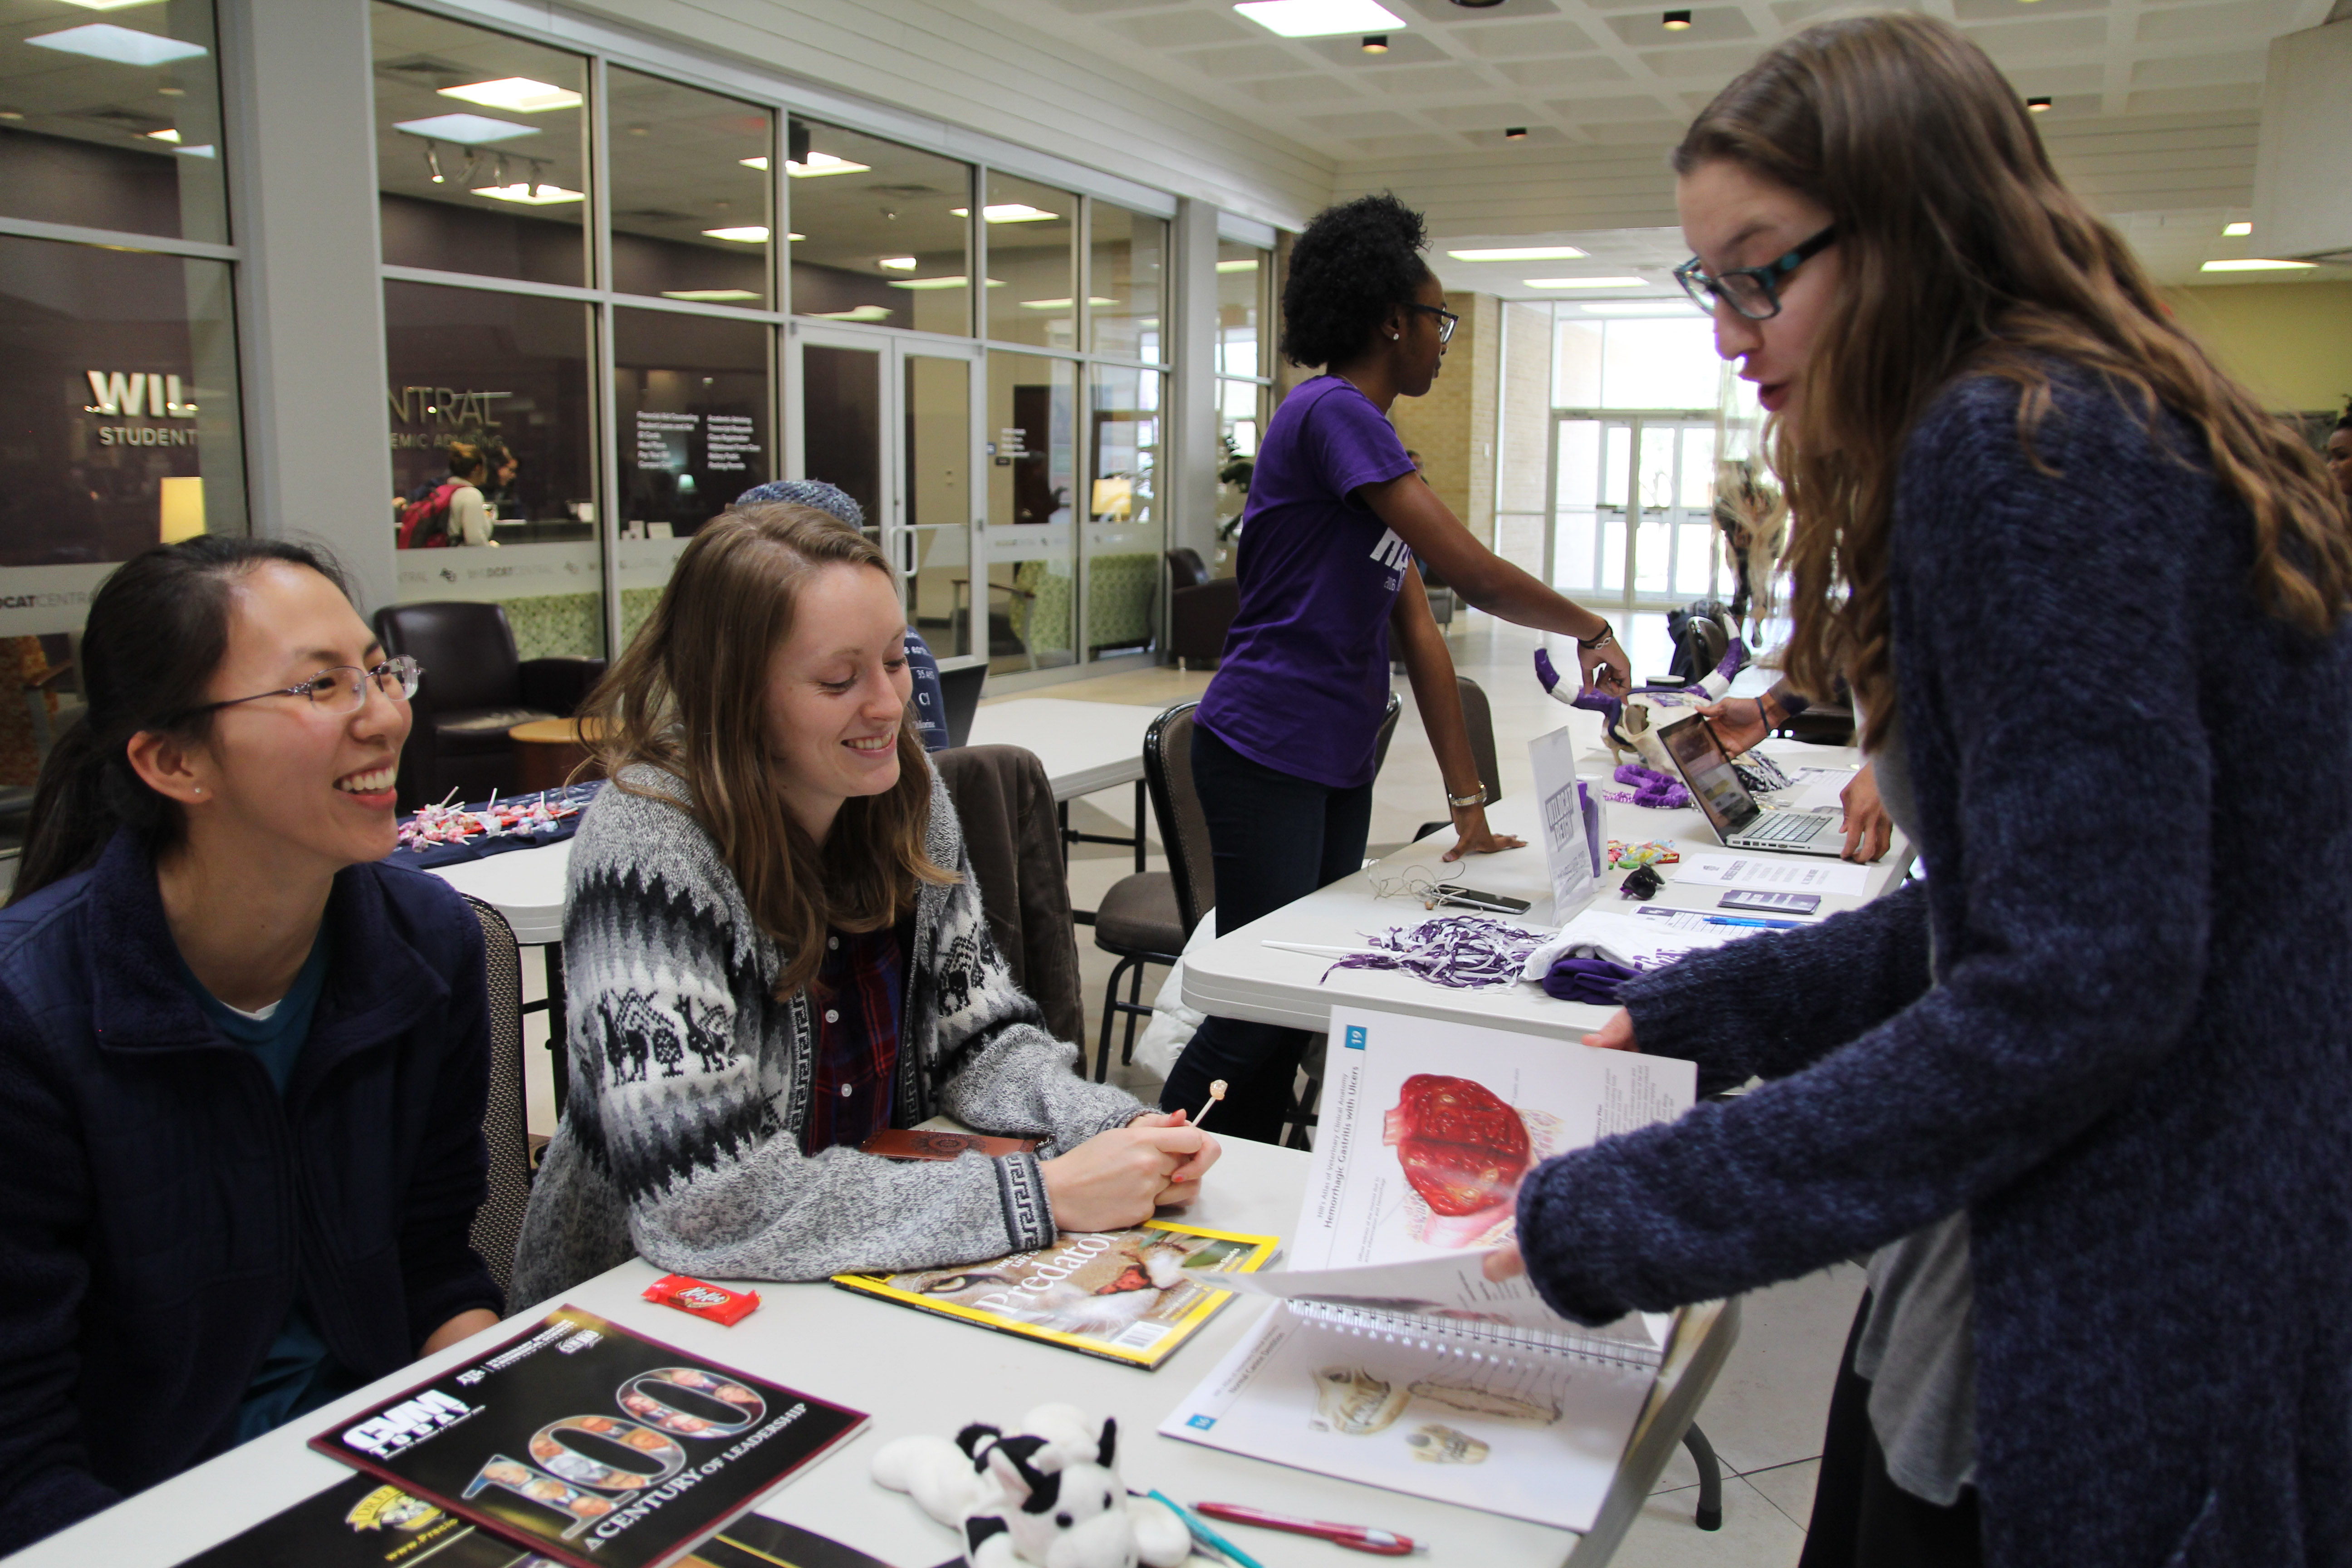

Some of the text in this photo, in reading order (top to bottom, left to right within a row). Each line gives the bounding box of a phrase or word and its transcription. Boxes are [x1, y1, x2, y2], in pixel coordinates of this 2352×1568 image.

[389, 386, 501, 427] NTRAL
[98, 426, 196, 446] STUDENT
[1546, 784, 1572, 829] WILDCAT
[1555, 813, 1573, 849] REIGN
[1350, 1030, 1363, 1045] 19
[1337, 1073, 1349, 1105] Anatomy
[1332, 1107, 1343, 1132] Clinical
[1323, 1066, 1360, 1230] Hemorrhagic Gastritis with Ulcers
[1325, 1134, 1340, 1171] Veterinary
[1320, 1181, 1330, 1200] Atlas
[1323, 1172, 1332, 1180] of
[993, 1259, 1013, 1270] THE
[1011, 1254, 1033, 1268] LIFE
[485, 1318, 568, 1366] VETERINARY MEDICINE
[497, 1339, 544, 1365] BIOMEDICAL
[541, 1321, 575, 1342] SCIENCES
[342, 1389, 466, 1451] CVM
[368, 1402, 470, 1456] TODAY
[460, 1367, 767, 1541] 100
[583, 1402, 808, 1553] A CENTURY OF LEADERSHIP
